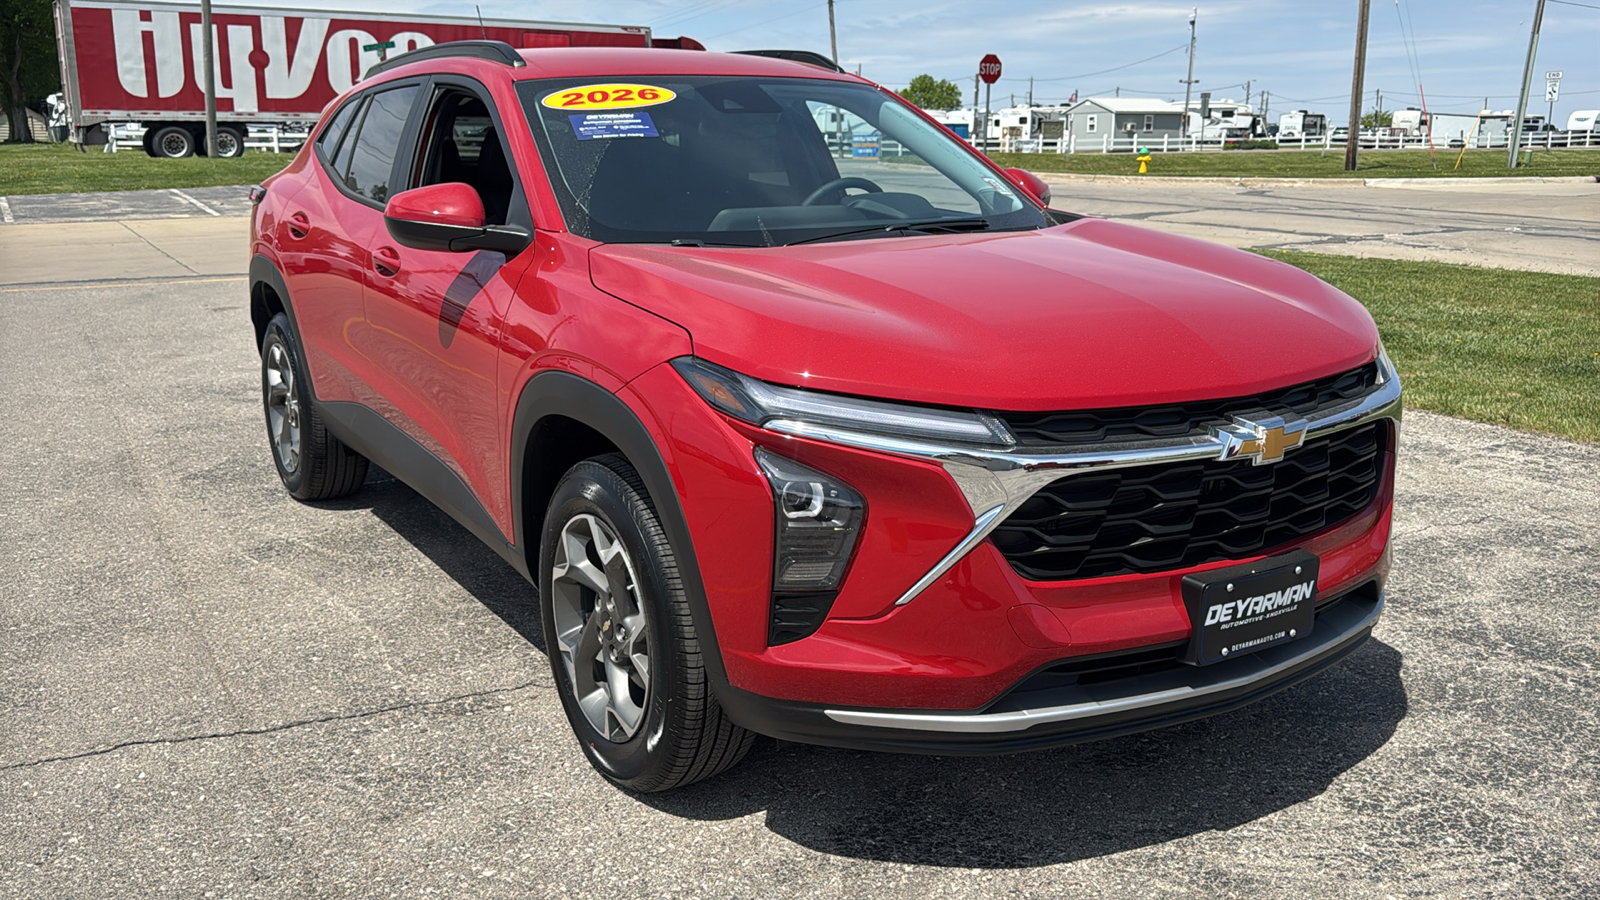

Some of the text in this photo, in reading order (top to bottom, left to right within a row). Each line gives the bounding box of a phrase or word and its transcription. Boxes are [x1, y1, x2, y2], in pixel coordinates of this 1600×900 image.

[980, 62, 1001, 75] STOP
[561, 88, 661, 107] 2026
[1204, 580, 1315, 627] DEYARMAN
[1231, 631, 1286, 652] DEYARMANAUTO.COM
